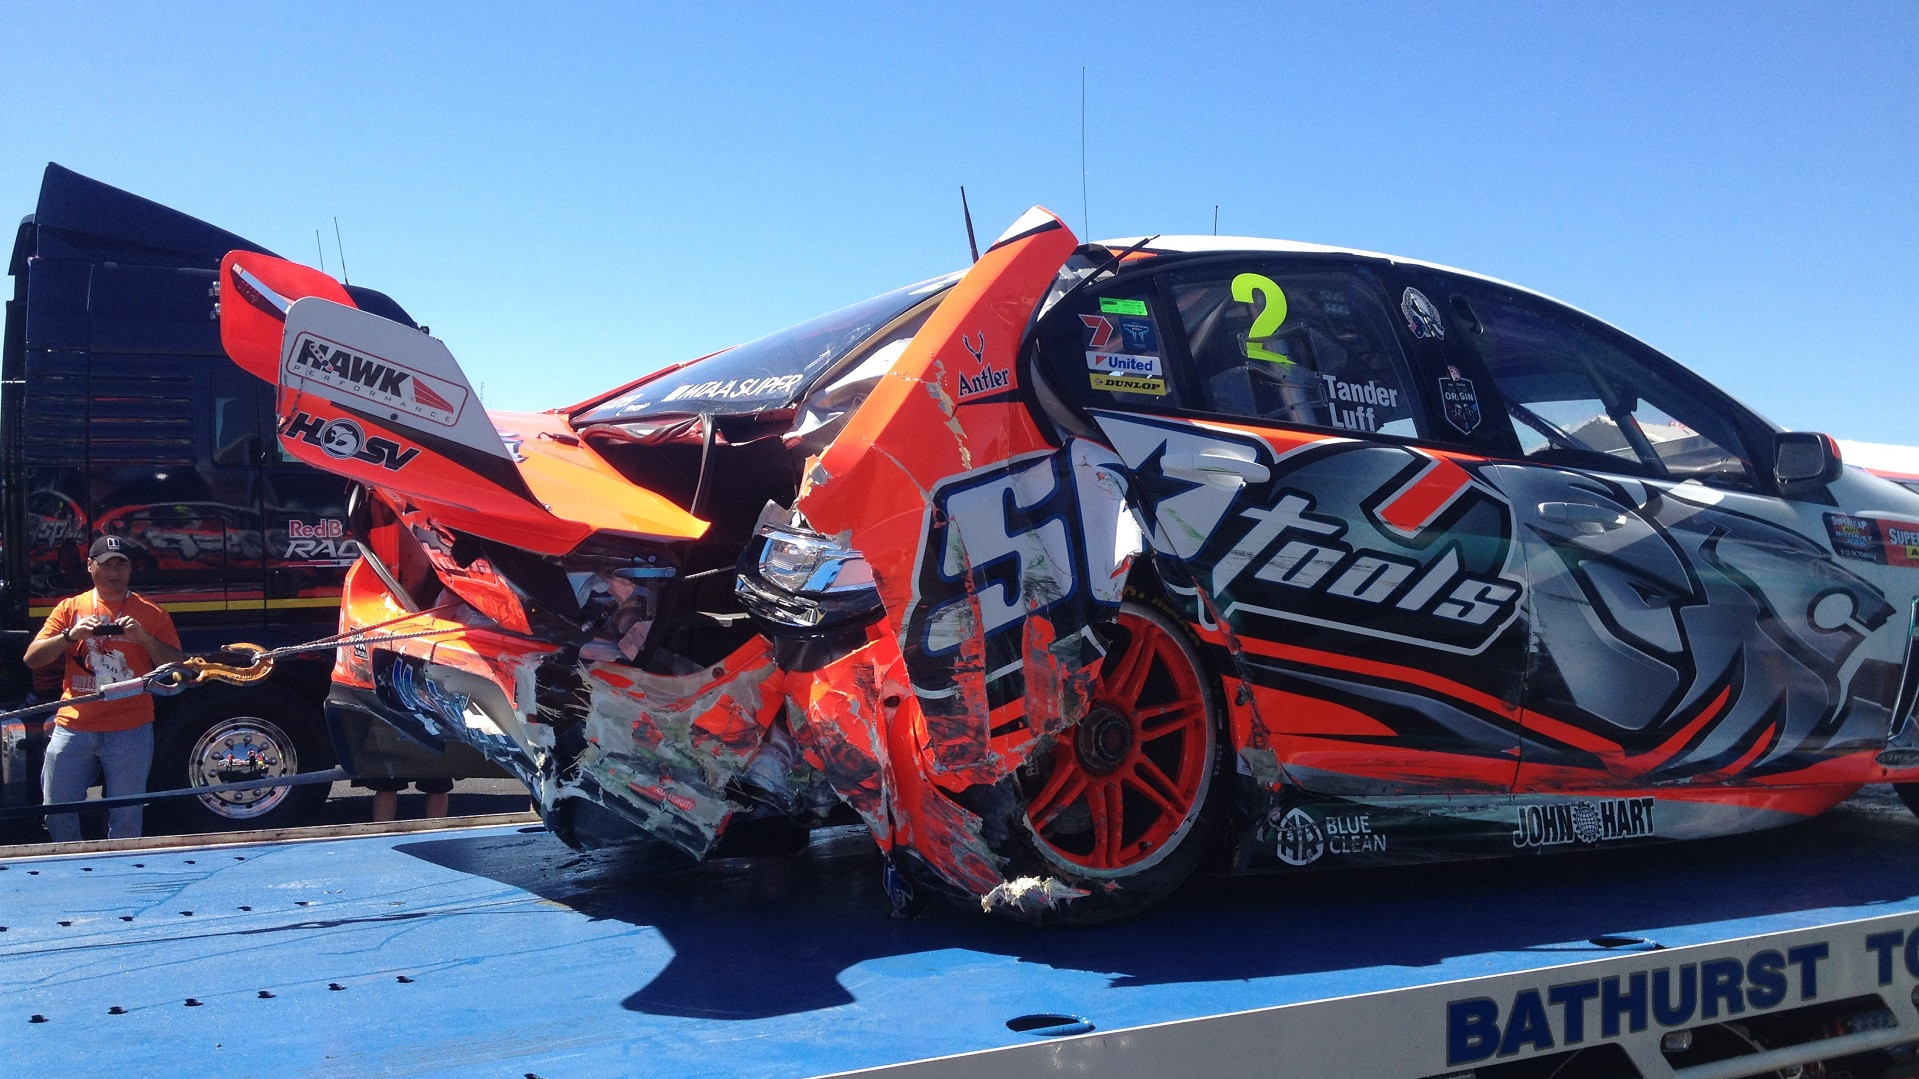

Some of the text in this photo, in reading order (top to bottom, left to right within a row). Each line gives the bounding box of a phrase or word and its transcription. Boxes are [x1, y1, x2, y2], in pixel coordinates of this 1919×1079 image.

[1231, 272, 1297, 365] 2
[296, 338, 411, 399] HAWK
[957, 362, 1010, 399] Antler
[1108, 356, 1153, 371] United
[293, 364, 452, 423] PERFORMANCE
[730, 373, 804, 398] SUPER
[1104, 379, 1161, 391] DUNLOP
[1323, 374, 1398, 408] Tander
[1328, 402, 1376, 432] Luff
[289, 518, 343, 538] Red B
[1212, 494, 1517, 625] tools
[1325, 815, 1372, 835] BLUE
[1512, 796, 1656, 849] JOHN HART
[1329, 834, 1387, 855] CLEAN
[1446, 941, 1830, 1067] BATHURST
